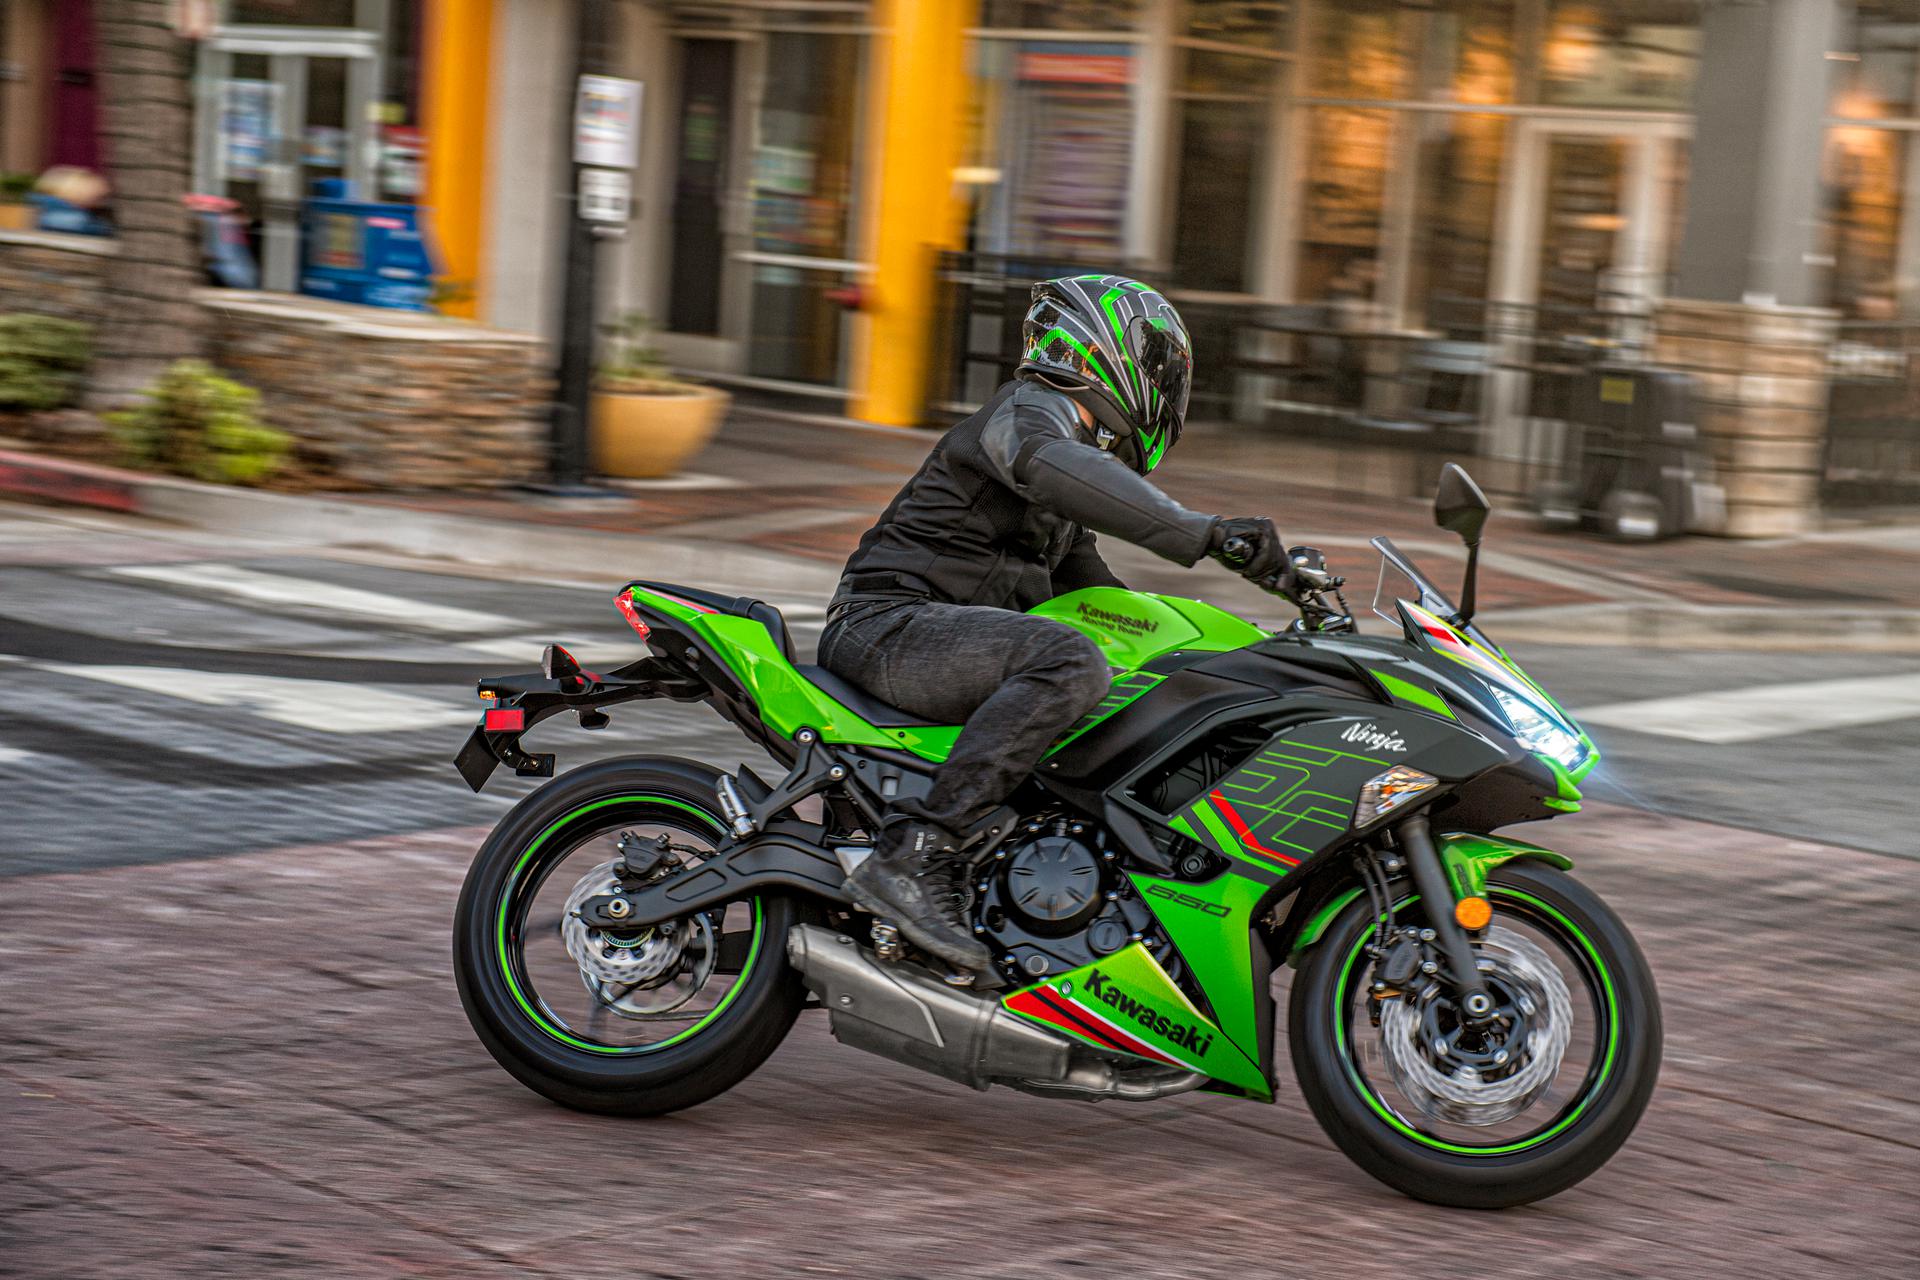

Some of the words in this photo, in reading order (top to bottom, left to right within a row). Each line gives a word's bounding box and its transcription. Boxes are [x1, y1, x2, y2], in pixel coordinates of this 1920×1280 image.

[1076, 602, 1159, 633] Kawasaki
[1341, 722, 1407, 752] Ninja
[1145, 884, 1232, 917] 650
[1083, 968, 1213, 1057] Kawasaki
